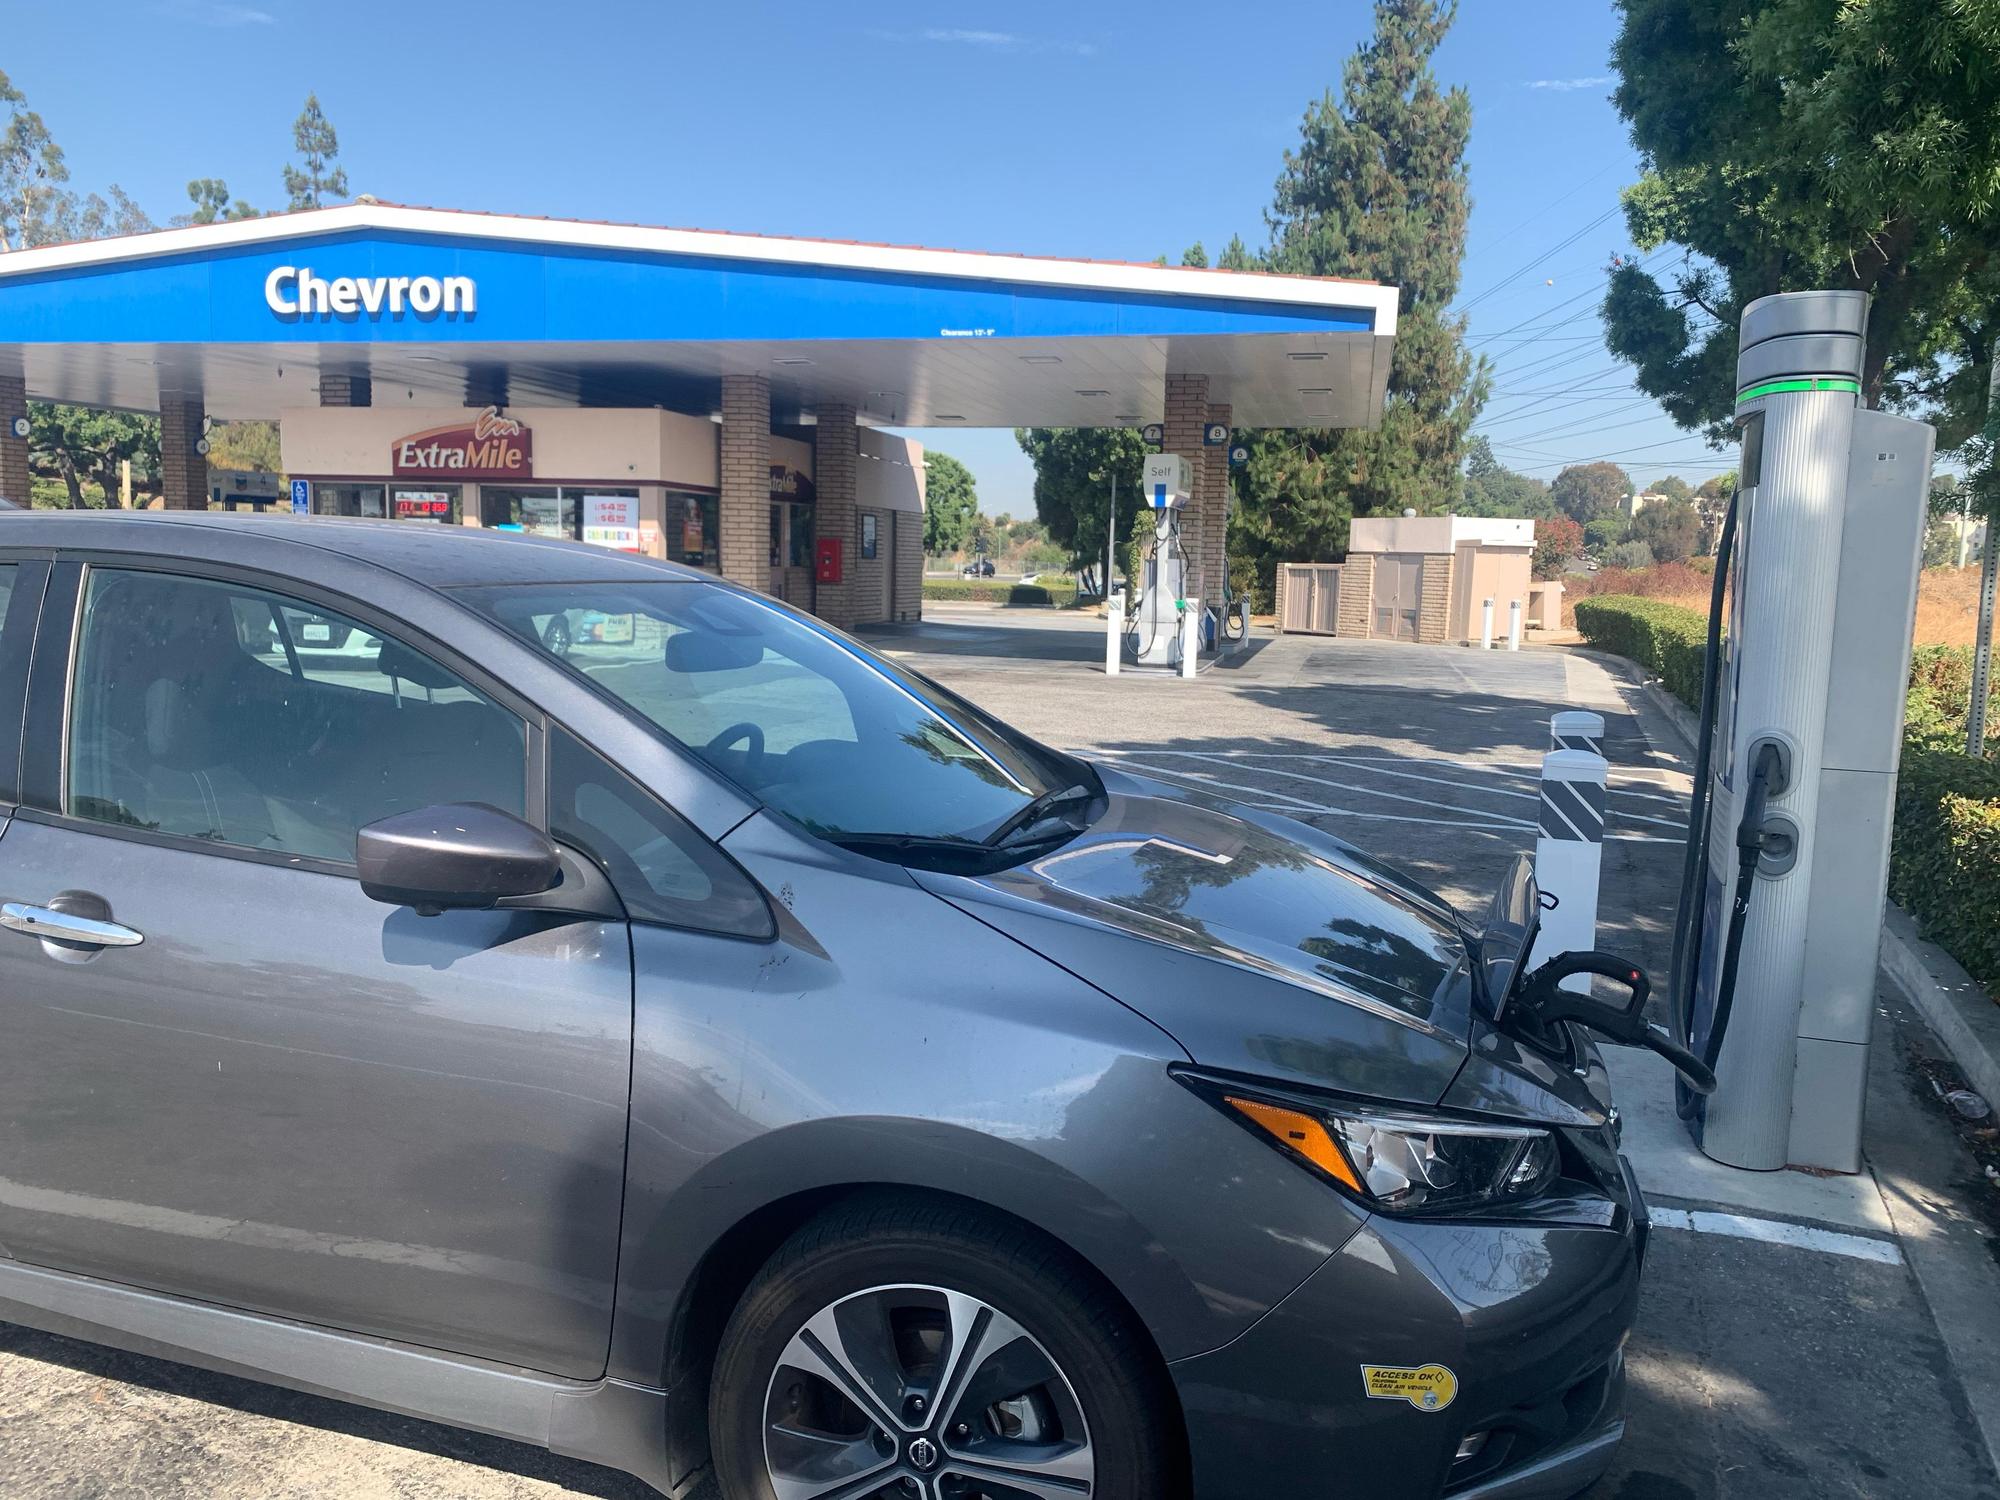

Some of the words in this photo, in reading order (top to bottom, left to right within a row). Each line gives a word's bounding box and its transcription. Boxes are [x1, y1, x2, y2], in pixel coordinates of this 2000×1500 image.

[265, 266, 476, 314] Chevron
[1150, 428, 1156, 438] 7
[1214, 428, 1221, 438] 8
[398, 440, 522, 470] ExtraMile
[1151, 466, 1172, 477] Self
[1373, 1371, 1416, 1380] ACCESS
[1418, 1373, 1434, 1381] OK
